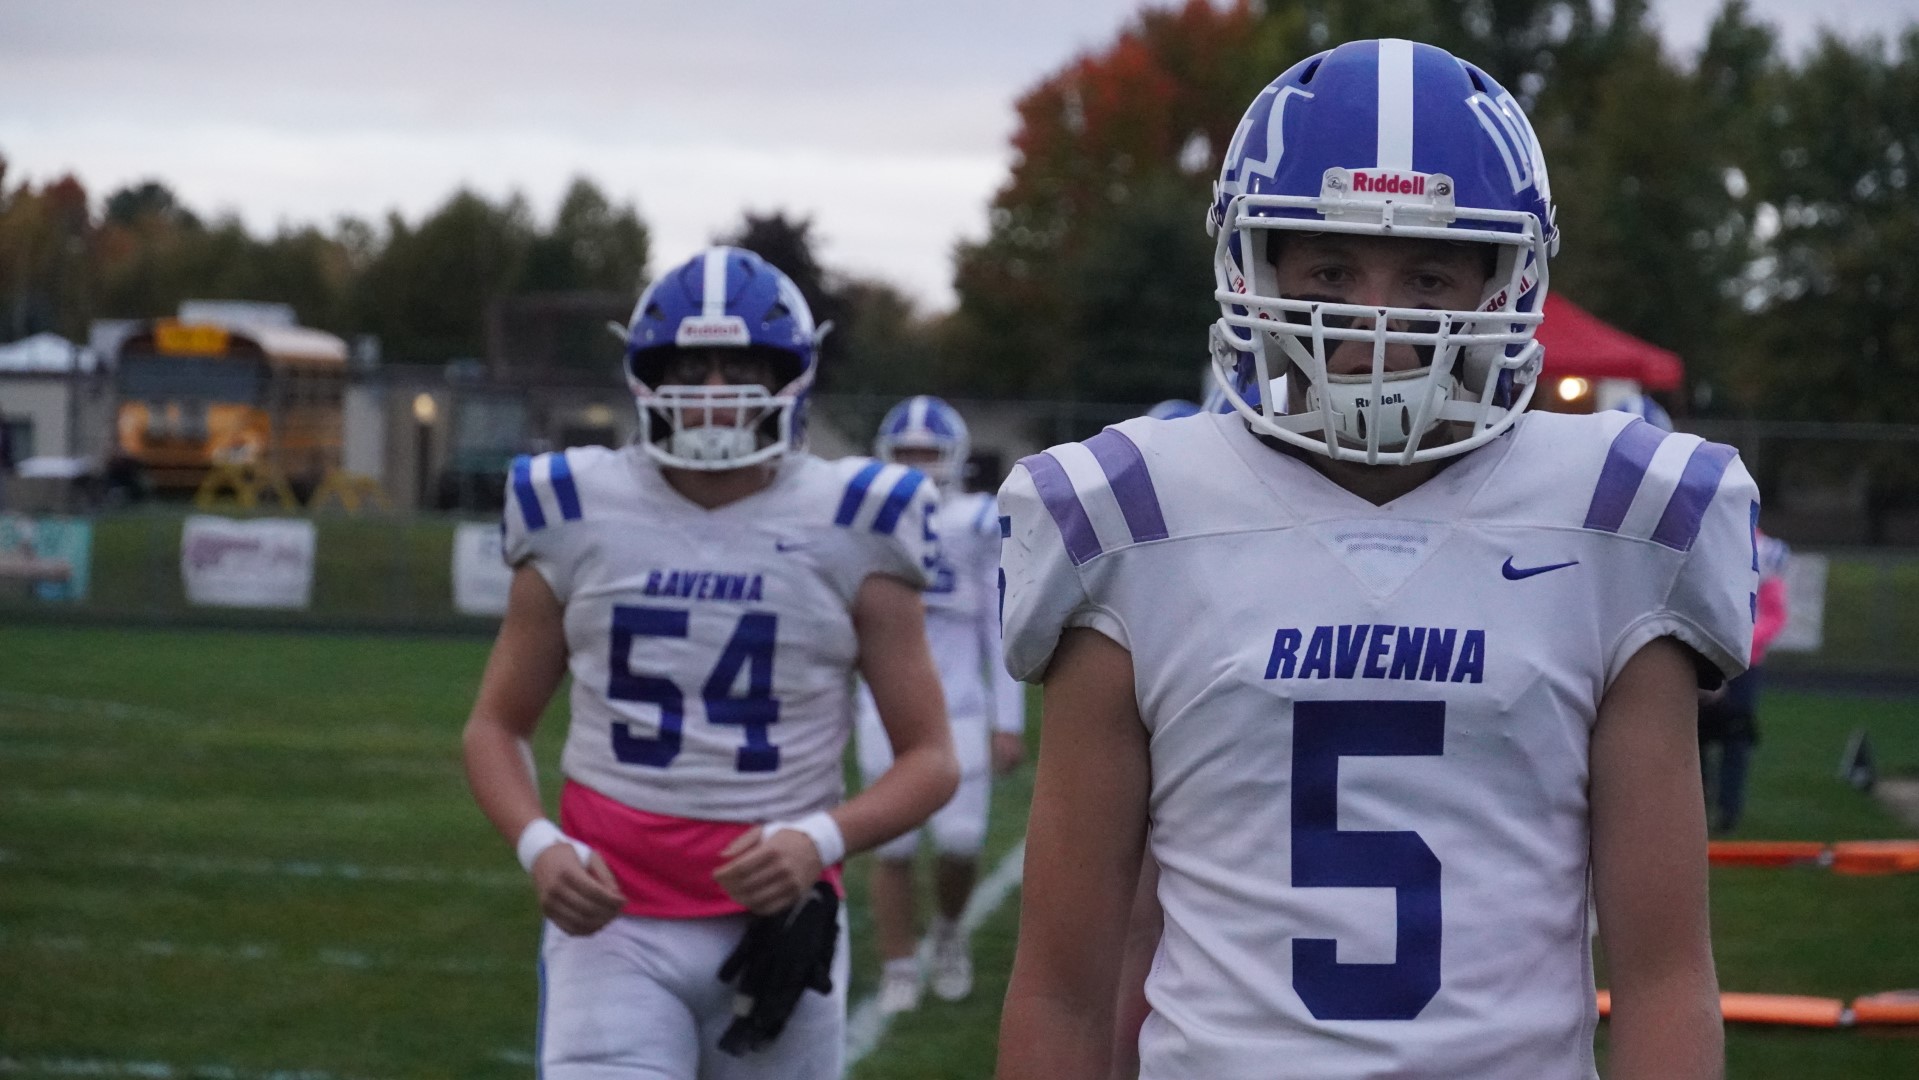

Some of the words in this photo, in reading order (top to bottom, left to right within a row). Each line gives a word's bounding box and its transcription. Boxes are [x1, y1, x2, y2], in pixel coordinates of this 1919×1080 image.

[1353, 172, 1425, 195] Riddell
[643, 571, 764, 601] RAVENNA
[1264, 625, 1486, 685] RAVENNA
[608, 604, 779, 772] 54
[1291, 701, 1446, 1021] 5
